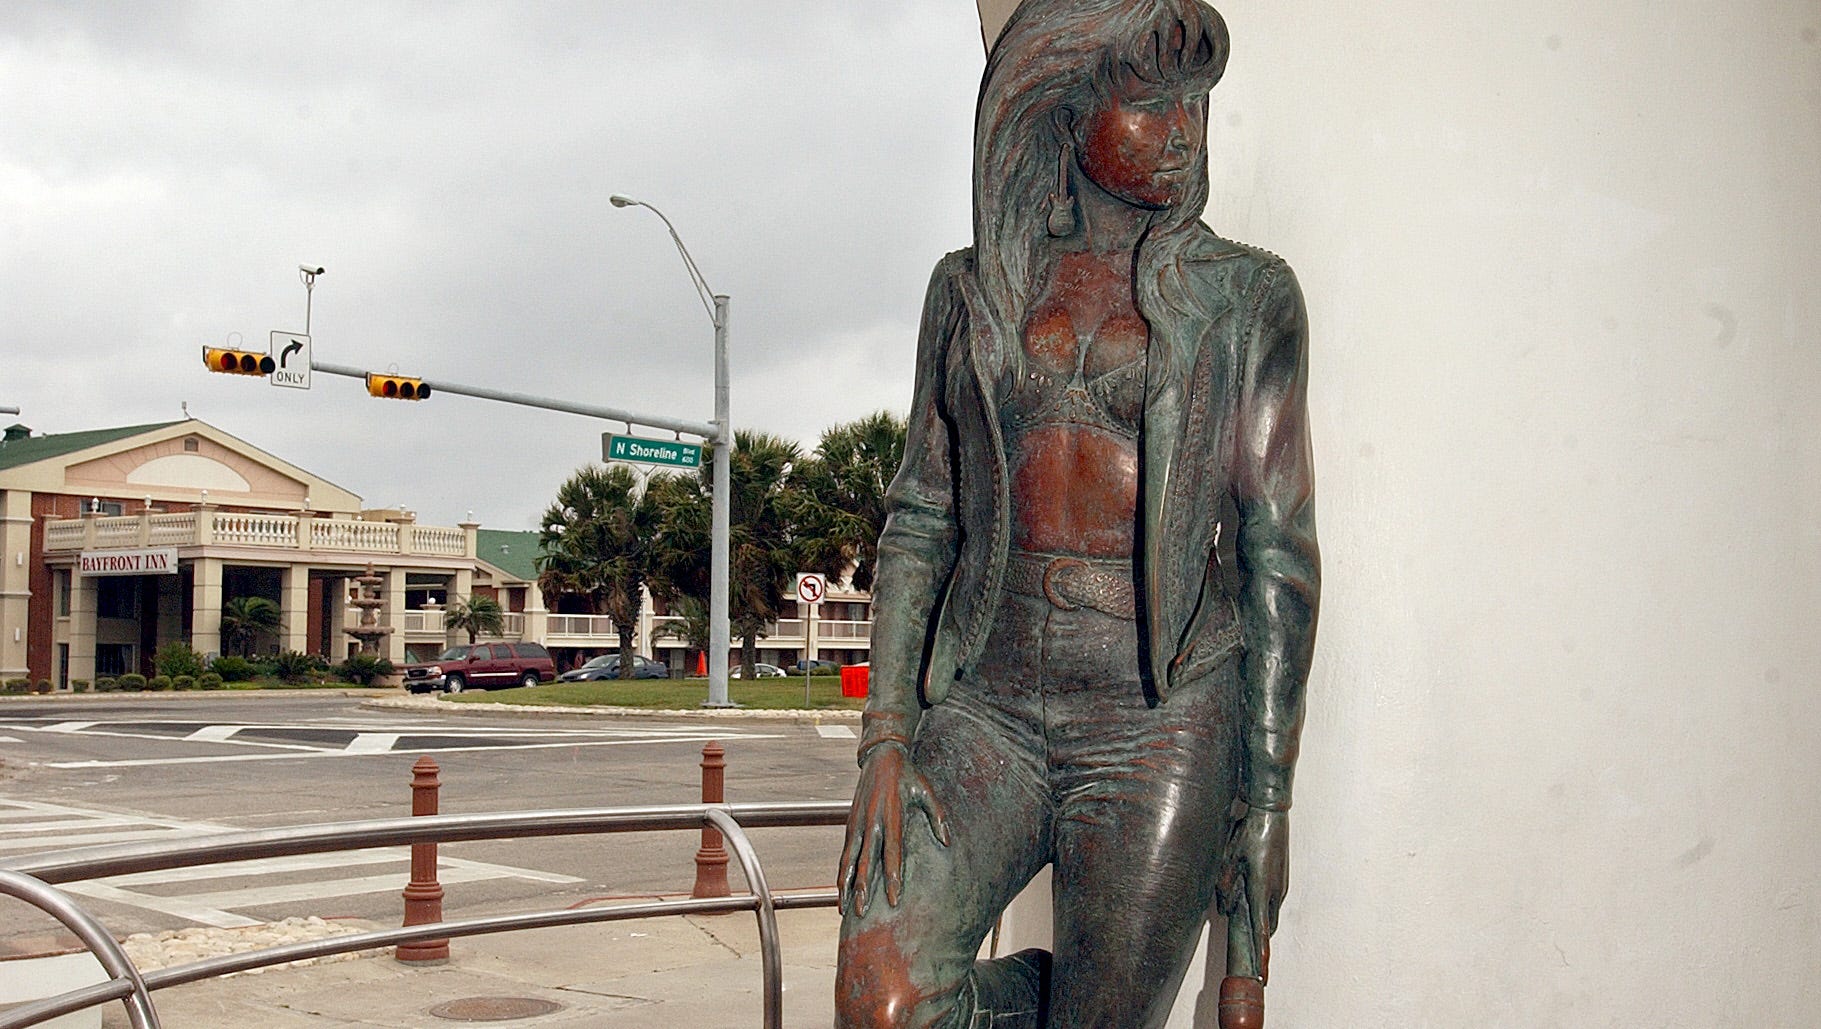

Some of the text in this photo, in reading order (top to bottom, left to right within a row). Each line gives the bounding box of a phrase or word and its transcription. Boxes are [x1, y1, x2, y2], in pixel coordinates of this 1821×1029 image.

[277, 371, 304, 384] ONLY
[616, 442, 677, 460] N Shoreline
[82, 553, 168, 571] BAYFRONT INN
